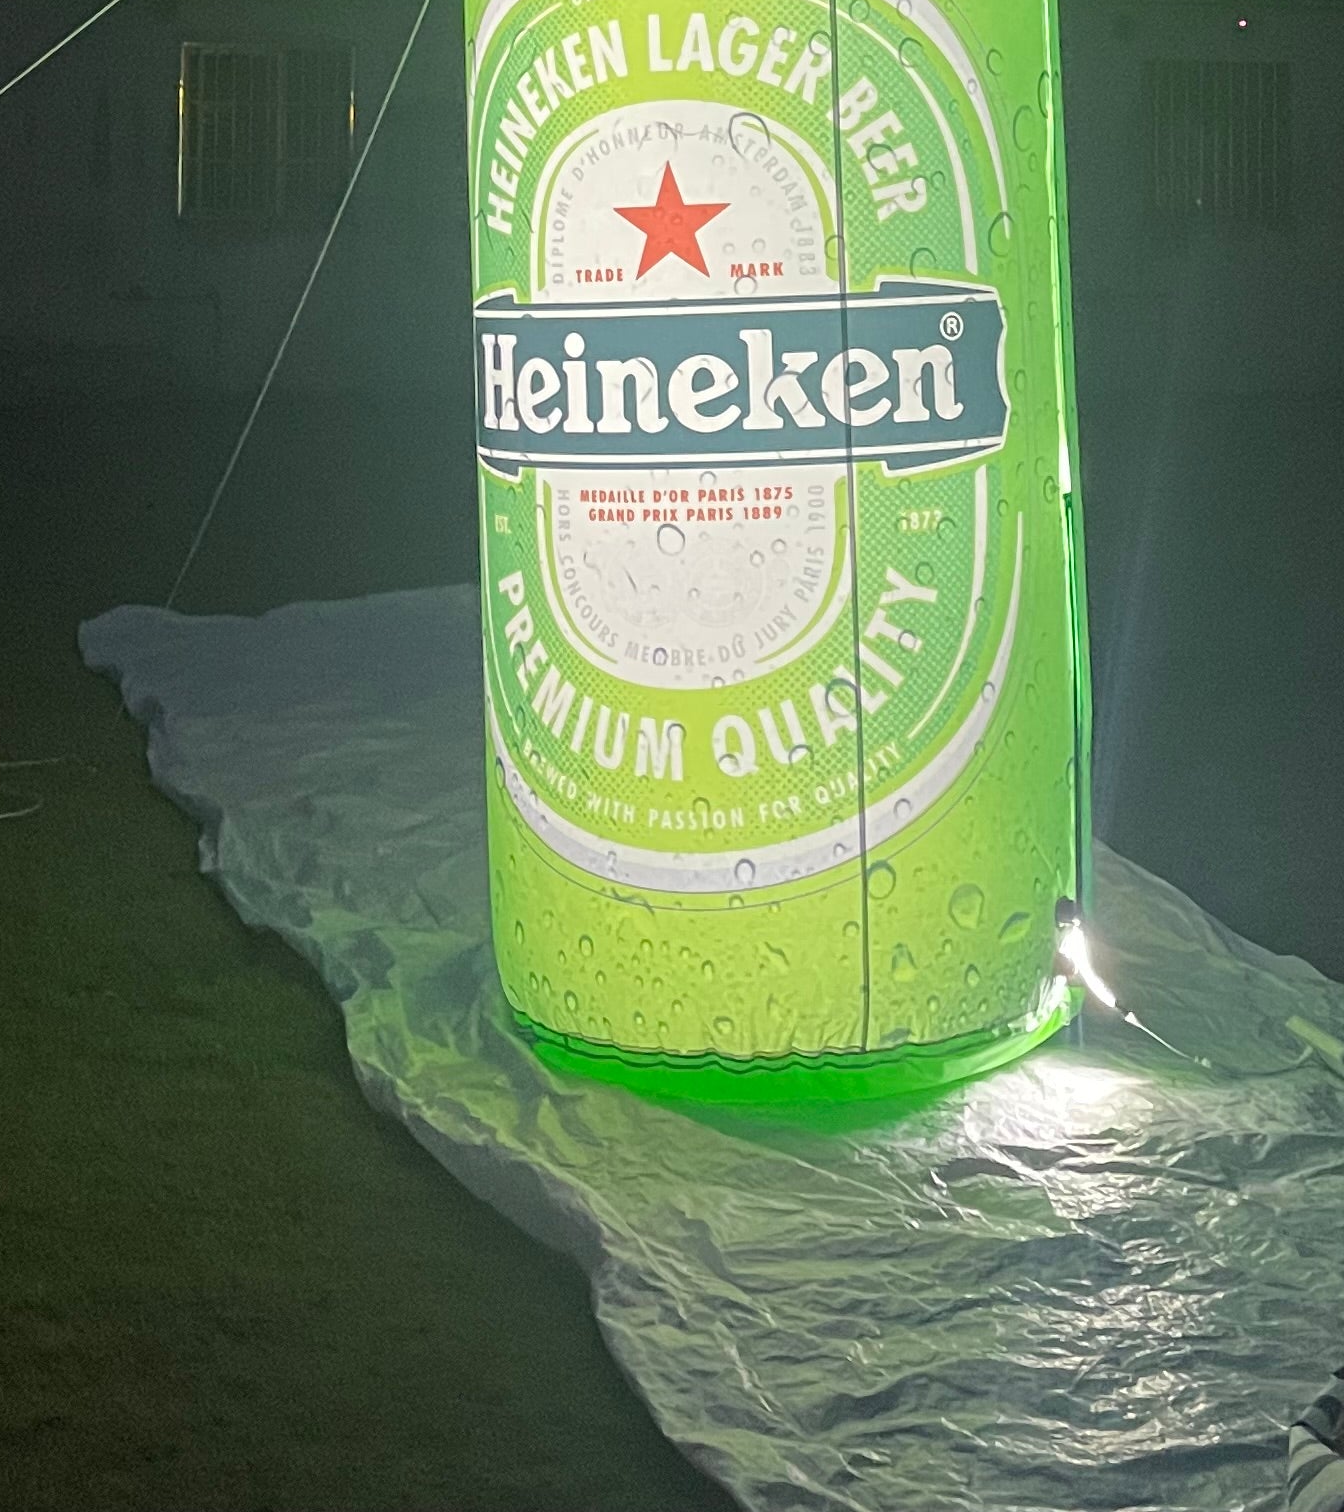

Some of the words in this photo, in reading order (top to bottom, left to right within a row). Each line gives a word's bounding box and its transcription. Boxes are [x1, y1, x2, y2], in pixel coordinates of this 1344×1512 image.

[486, 19, 628, 236] HEINEKEN
[647, 12, 832, 105] LAGER
[827, 77, 928, 222] BEER
[551, 187, 574, 285] DIPLOME
[699, 123, 809, 212] AMSTERDAM
[575, 268, 624, 284] TRADE
[730, 262, 784, 278] MARK
[557, 489, 572, 543] HORS
[580, 489, 645, 503] MEDAILLE
[652, 489, 690, 503] D'OR
[698, 488, 746, 502] PARIS
[754, 486, 794, 501] 1875
[588, 508, 636, 522] GRAND
[642, 508, 679, 522] PRIX
[686, 507, 734, 521] PARIS
[743, 506, 783, 520] 1889
[807, 484, 825, 534] 1900
[793, 545, 825, 603] PARIS
[560, 554, 619, 648] CONCOURS
[757, 604, 798, 651] JURY
[498, 569, 684, 783] PREMIUM
[712, 565, 940, 779] QUALITY
[586, 791, 635, 825] WITH
[648, 806, 744, 830] PASSION
[758, 795, 802, 822] FOR
